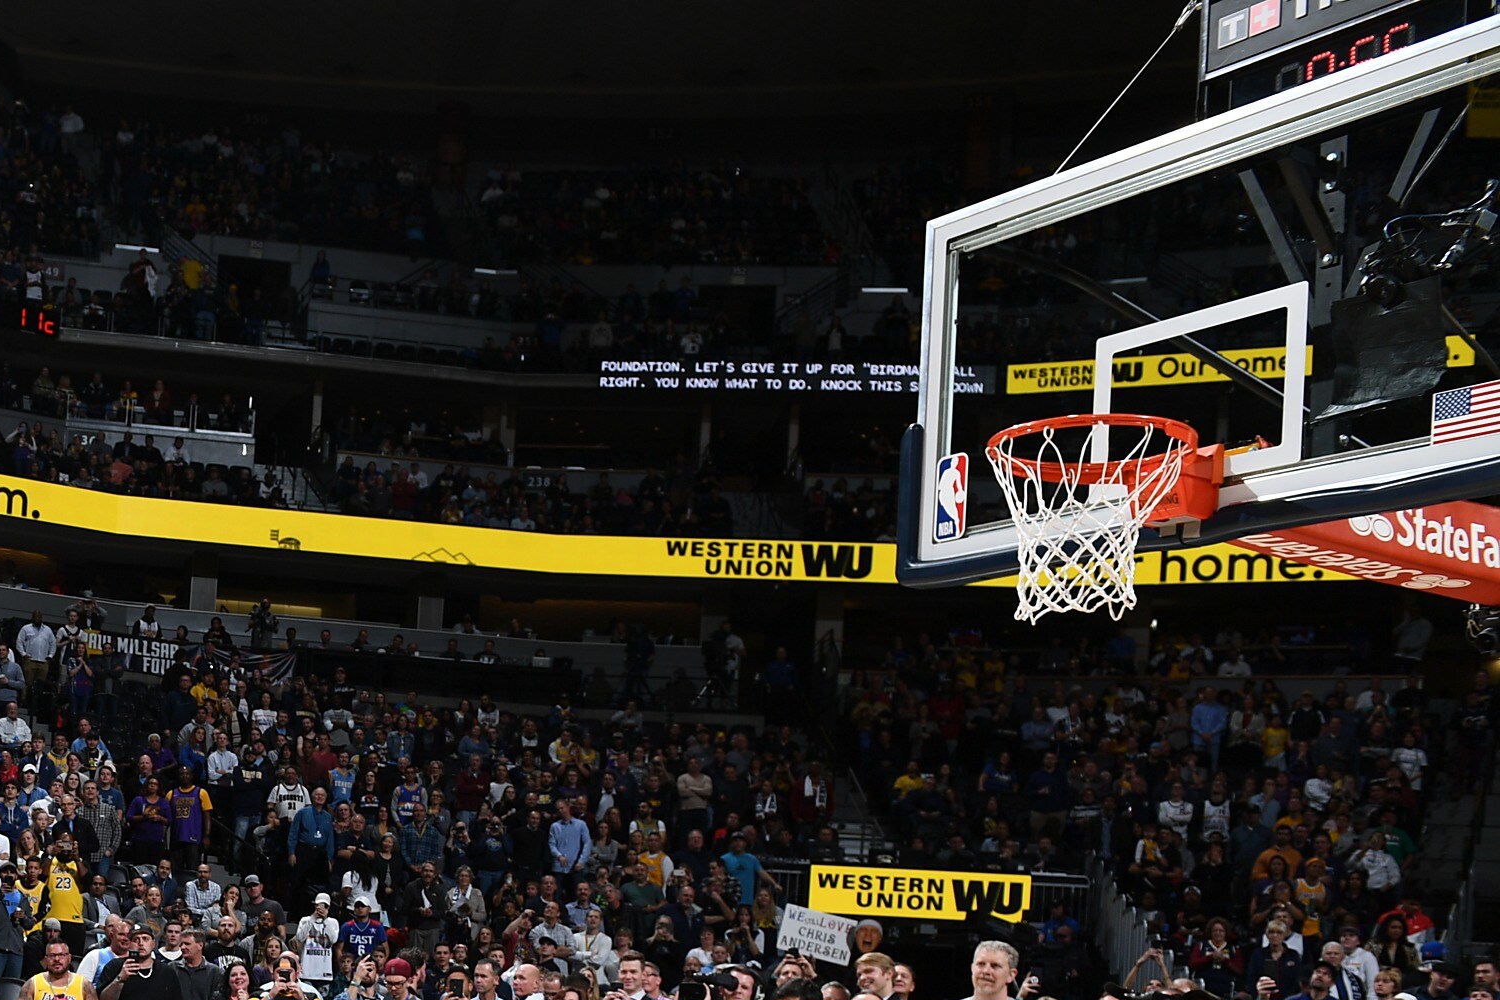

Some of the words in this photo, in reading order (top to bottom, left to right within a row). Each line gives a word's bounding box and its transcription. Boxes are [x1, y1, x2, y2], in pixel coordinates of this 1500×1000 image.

[601, 361, 685, 372] FOUNDATION.
[695, 361, 735, 373] LET'S
[741, 363, 775, 374] GIVE
[782, 363, 799, 374] IT
[805, 364, 823, 375] UP
[830, 364, 855, 375] FOR
[1013, 364, 1094, 380] WESTERN
[600, 377, 645, 388] RIGHT.
[655, 378, 680, 389] YOU
[685, 378, 719, 389] KNOW
[725, 379, 758, 390] WHAT
[764, 380, 782, 390] TO
[789, 380, 812, 391] DO.
[821, 380, 862, 391] KNOCK
[869, 381, 902, 392] THIS
[1038, 375, 1093, 388] UNION
[938, 520, 954, 538] NBA
[1396, 508, 1500, 568] StateFa
[666, 541, 794, 559] WESTERN
[705, 559, 793, 577] UNION
[801, 544, 874, 579] WU
[1160, 550, 1324, 581] home.
[288, 802, 297, 810] 31
[55, 877, 71, 891] 23
[817, 873, 944, 894] WESTERN
[856, 892, 944, 912] UNION
[952, 879, 1024, 916] WU
[789, 909, 806, 923] WE
[350, 934, 374, 945] EAST
[799, 926, 837, 945] CHRIS
[306, 948, 331, 956] NUGGETS
[358, 945, 366, 957] 6
[780, 935, 848, 961] ANDERSEN
